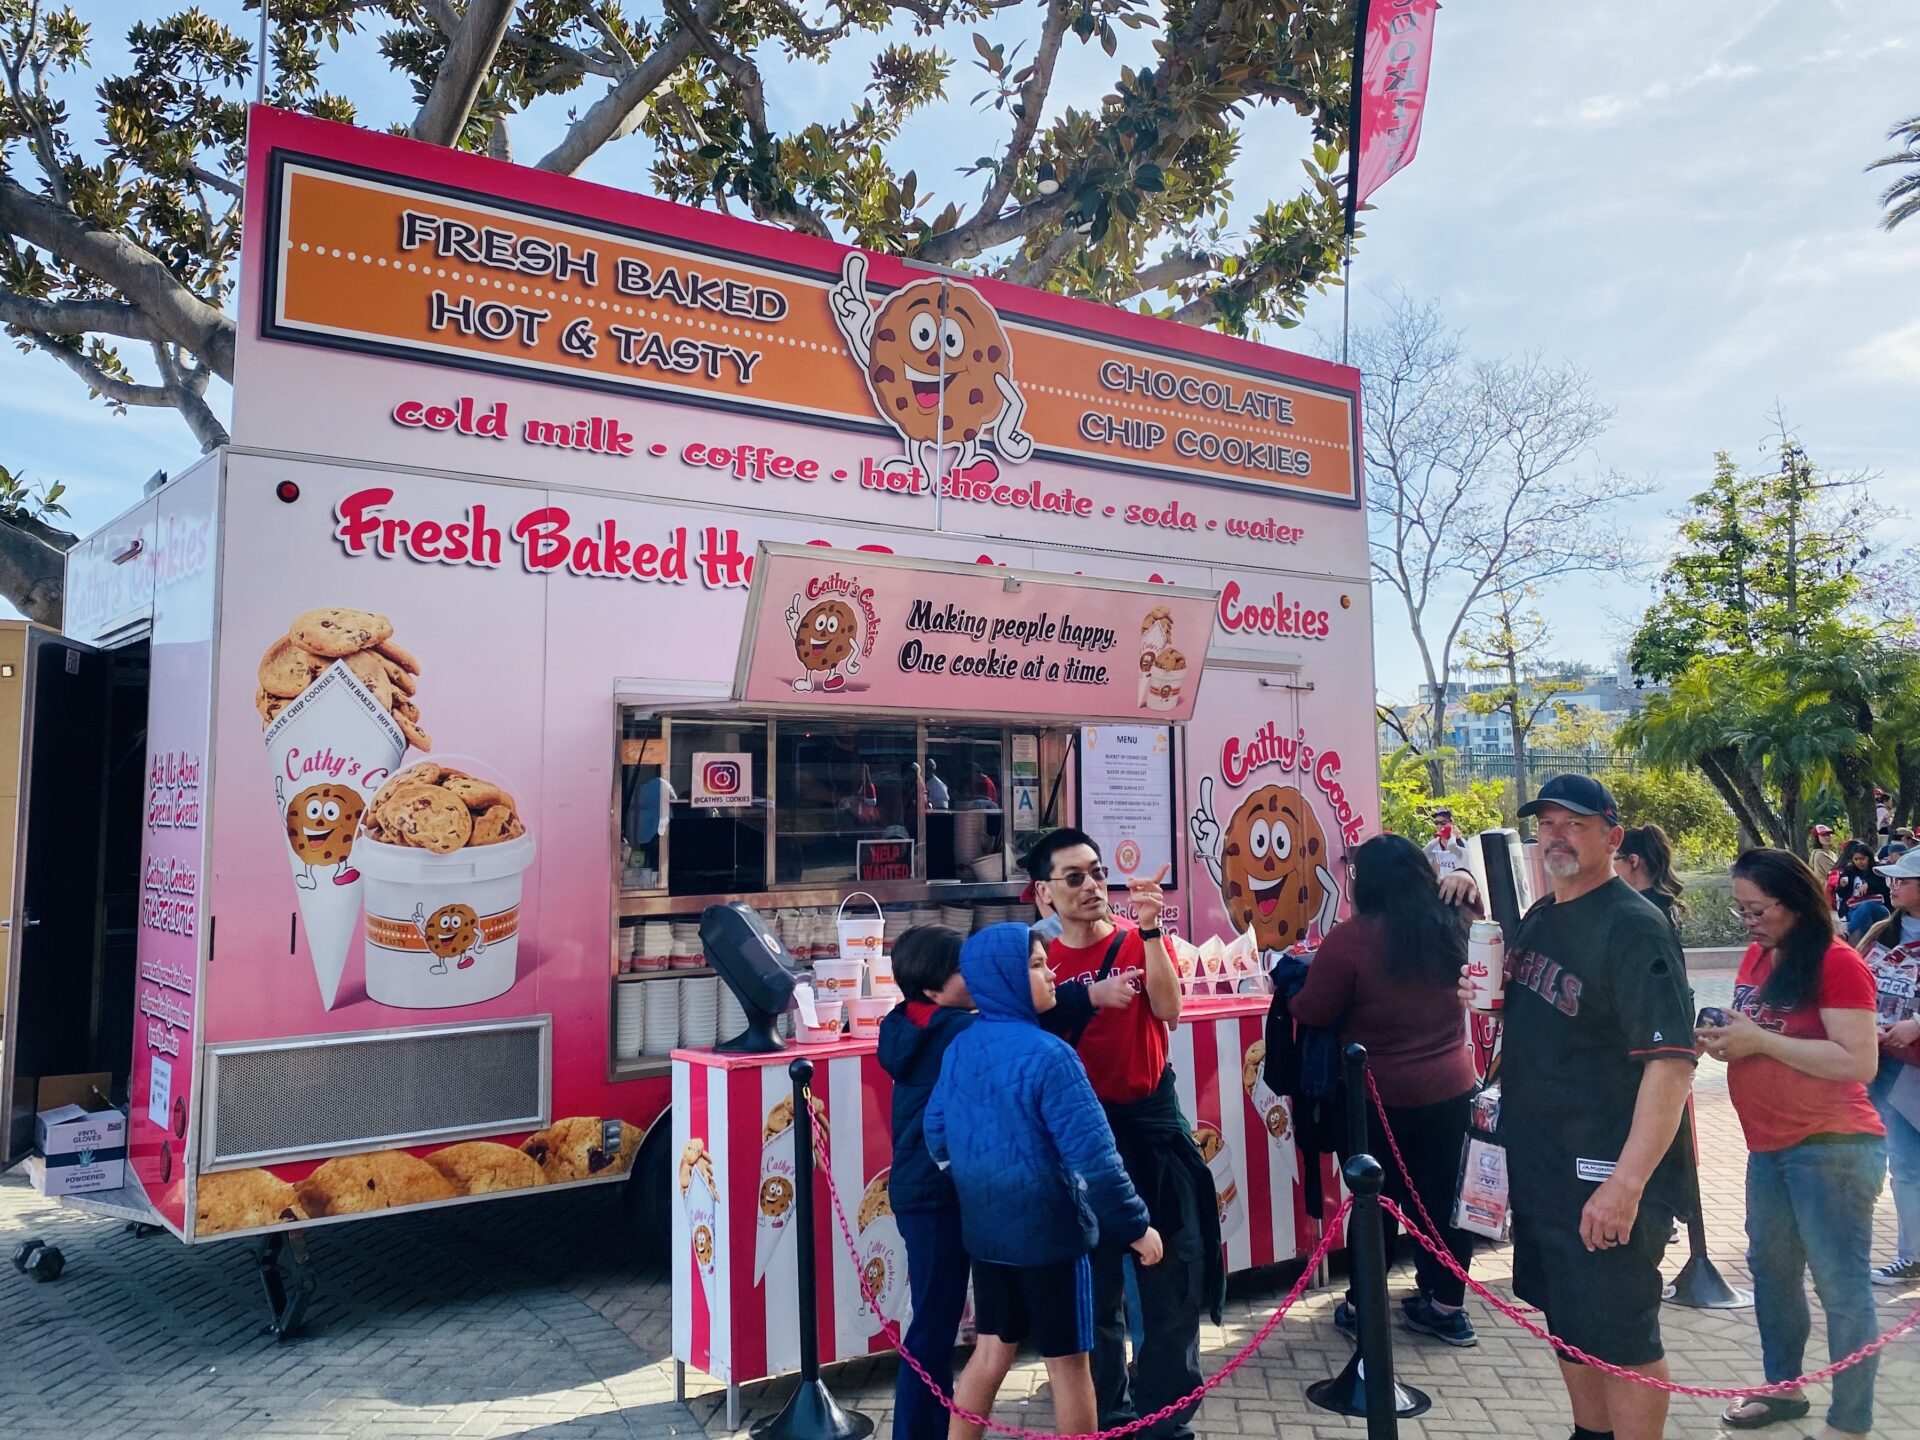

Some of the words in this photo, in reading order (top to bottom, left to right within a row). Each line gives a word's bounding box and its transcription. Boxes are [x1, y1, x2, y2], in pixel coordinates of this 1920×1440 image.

[401, 209, 597, 286] FRESH
[617, 255, 789, 321] BAKED
[431, 290, 550, 347] HOT
[561, 317, 596, 359] &
[609, 325, 762, 383] TASTY
[1100, 361, 1295, 425] CHOCOLATE
[1080, 412, 1165, 450] CHIP
[1175, 429, 1311, 476] COOKIES
[394, 398, 509, 439] cold
[525, 415, 635, 455] milk
[682, 439, 819, 481] coffee
[862, 457, 925, 493] hot
[934, 469, 1094, 515] chocolate
[1125, 500, 1198, 529] soda
[1226, 517, 1305, 545] water
[336, 487, 502, 568] Fresh
[514, 507, 689, 583] Baked
[1217, 581, 1331, 637] Cookies
[806, 572, 860, 600] Cathy's
[858, 588, 881, 657] Cookies
[907, 599, 988, 642] Making
[990, 613, 1055, 648] people
[1060, 613, 1118, 650] happy.
[899, 638, 945, 672] One
[950, 646, 1019, 678] cookie
[1023, 658, 1045, 680] at
[1046, 665, 1060, 681] a
[1065, 655, 1110, 685] time.
[287, 700, 305, 718] CHIP
[304, 673, 336, 703] COOKIES
[334, 666, 356, 690] FRESH
[354, 688, 377, 713] BAKED
[1116, 735, 1138, 744] MENU
[177, 751, 199, 788] About
[286, 747, 361, 782] Cathy's
[1221, 721, 1315, 787] Cathy's
[1314, 750, 1364, 847] Cook
[148, 790, 174, 833] Special
[174, 789, 199, 828] Events
[725, 795, 750, 803] COOKIES
[1018, 789, 1033, 811] A
[169, 857, 195, 896] Cookies
[863, 864, 909, 881] WANTED
[870, 845, 900, 863] HELP
[1504, 947, 1582, 1017] GELS
[73, 1135, 101, 1143] GLOVES
[78, 1129, 97, 1137] VINYL
[65, 1173, 105, 1183] POWDERED
